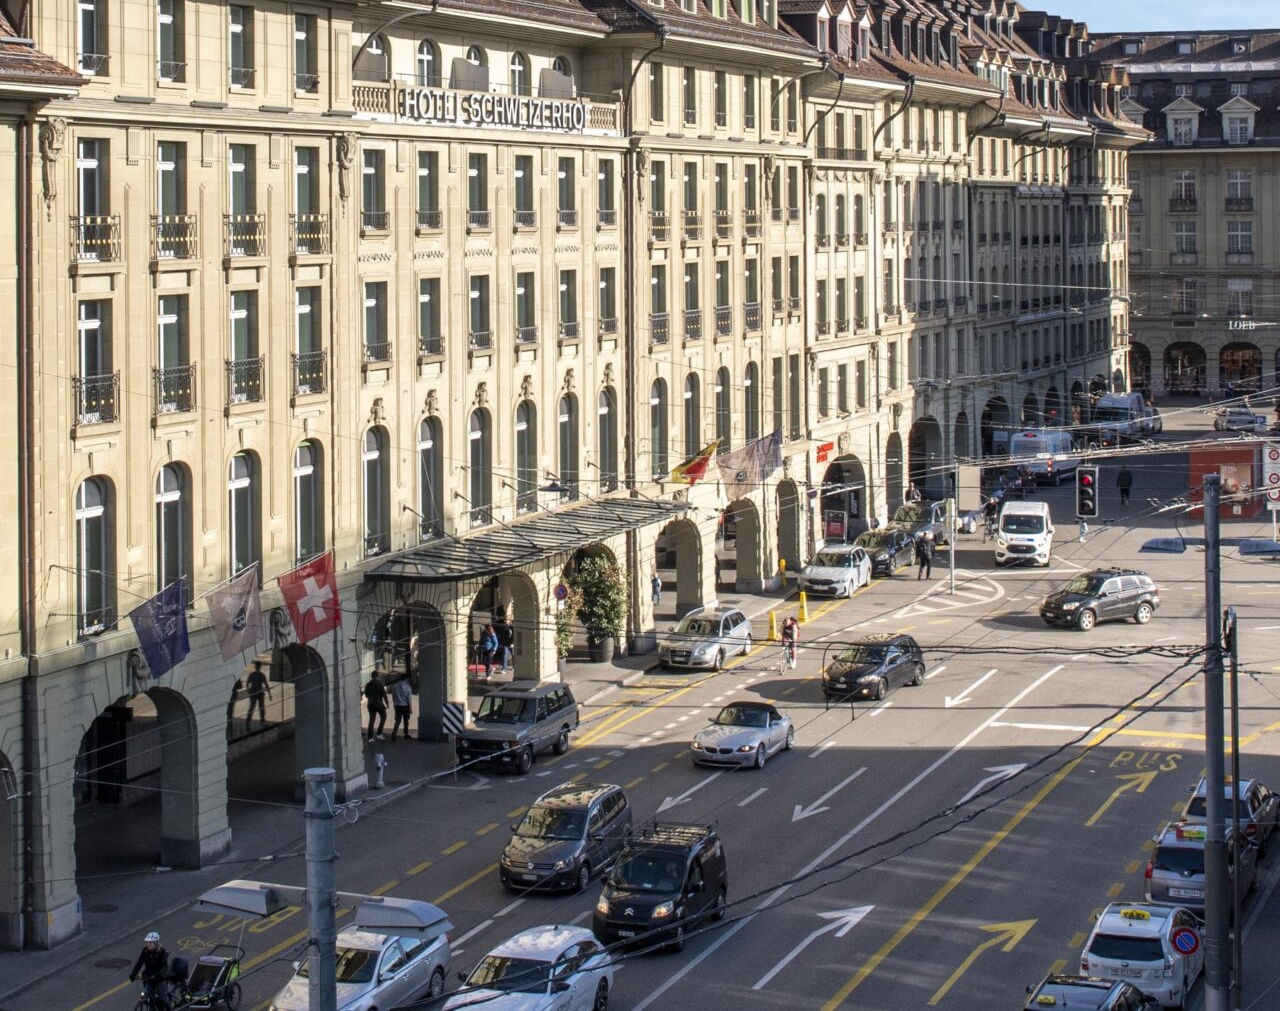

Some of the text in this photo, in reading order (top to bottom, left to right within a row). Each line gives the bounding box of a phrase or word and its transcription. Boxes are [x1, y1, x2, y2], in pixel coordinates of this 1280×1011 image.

[404, 88, 593, 130] HOTEL SCHWEIZERHOF
[1228, 320, 1255, 330] LOEB
[1108, 750, 1182, 771] BUS
